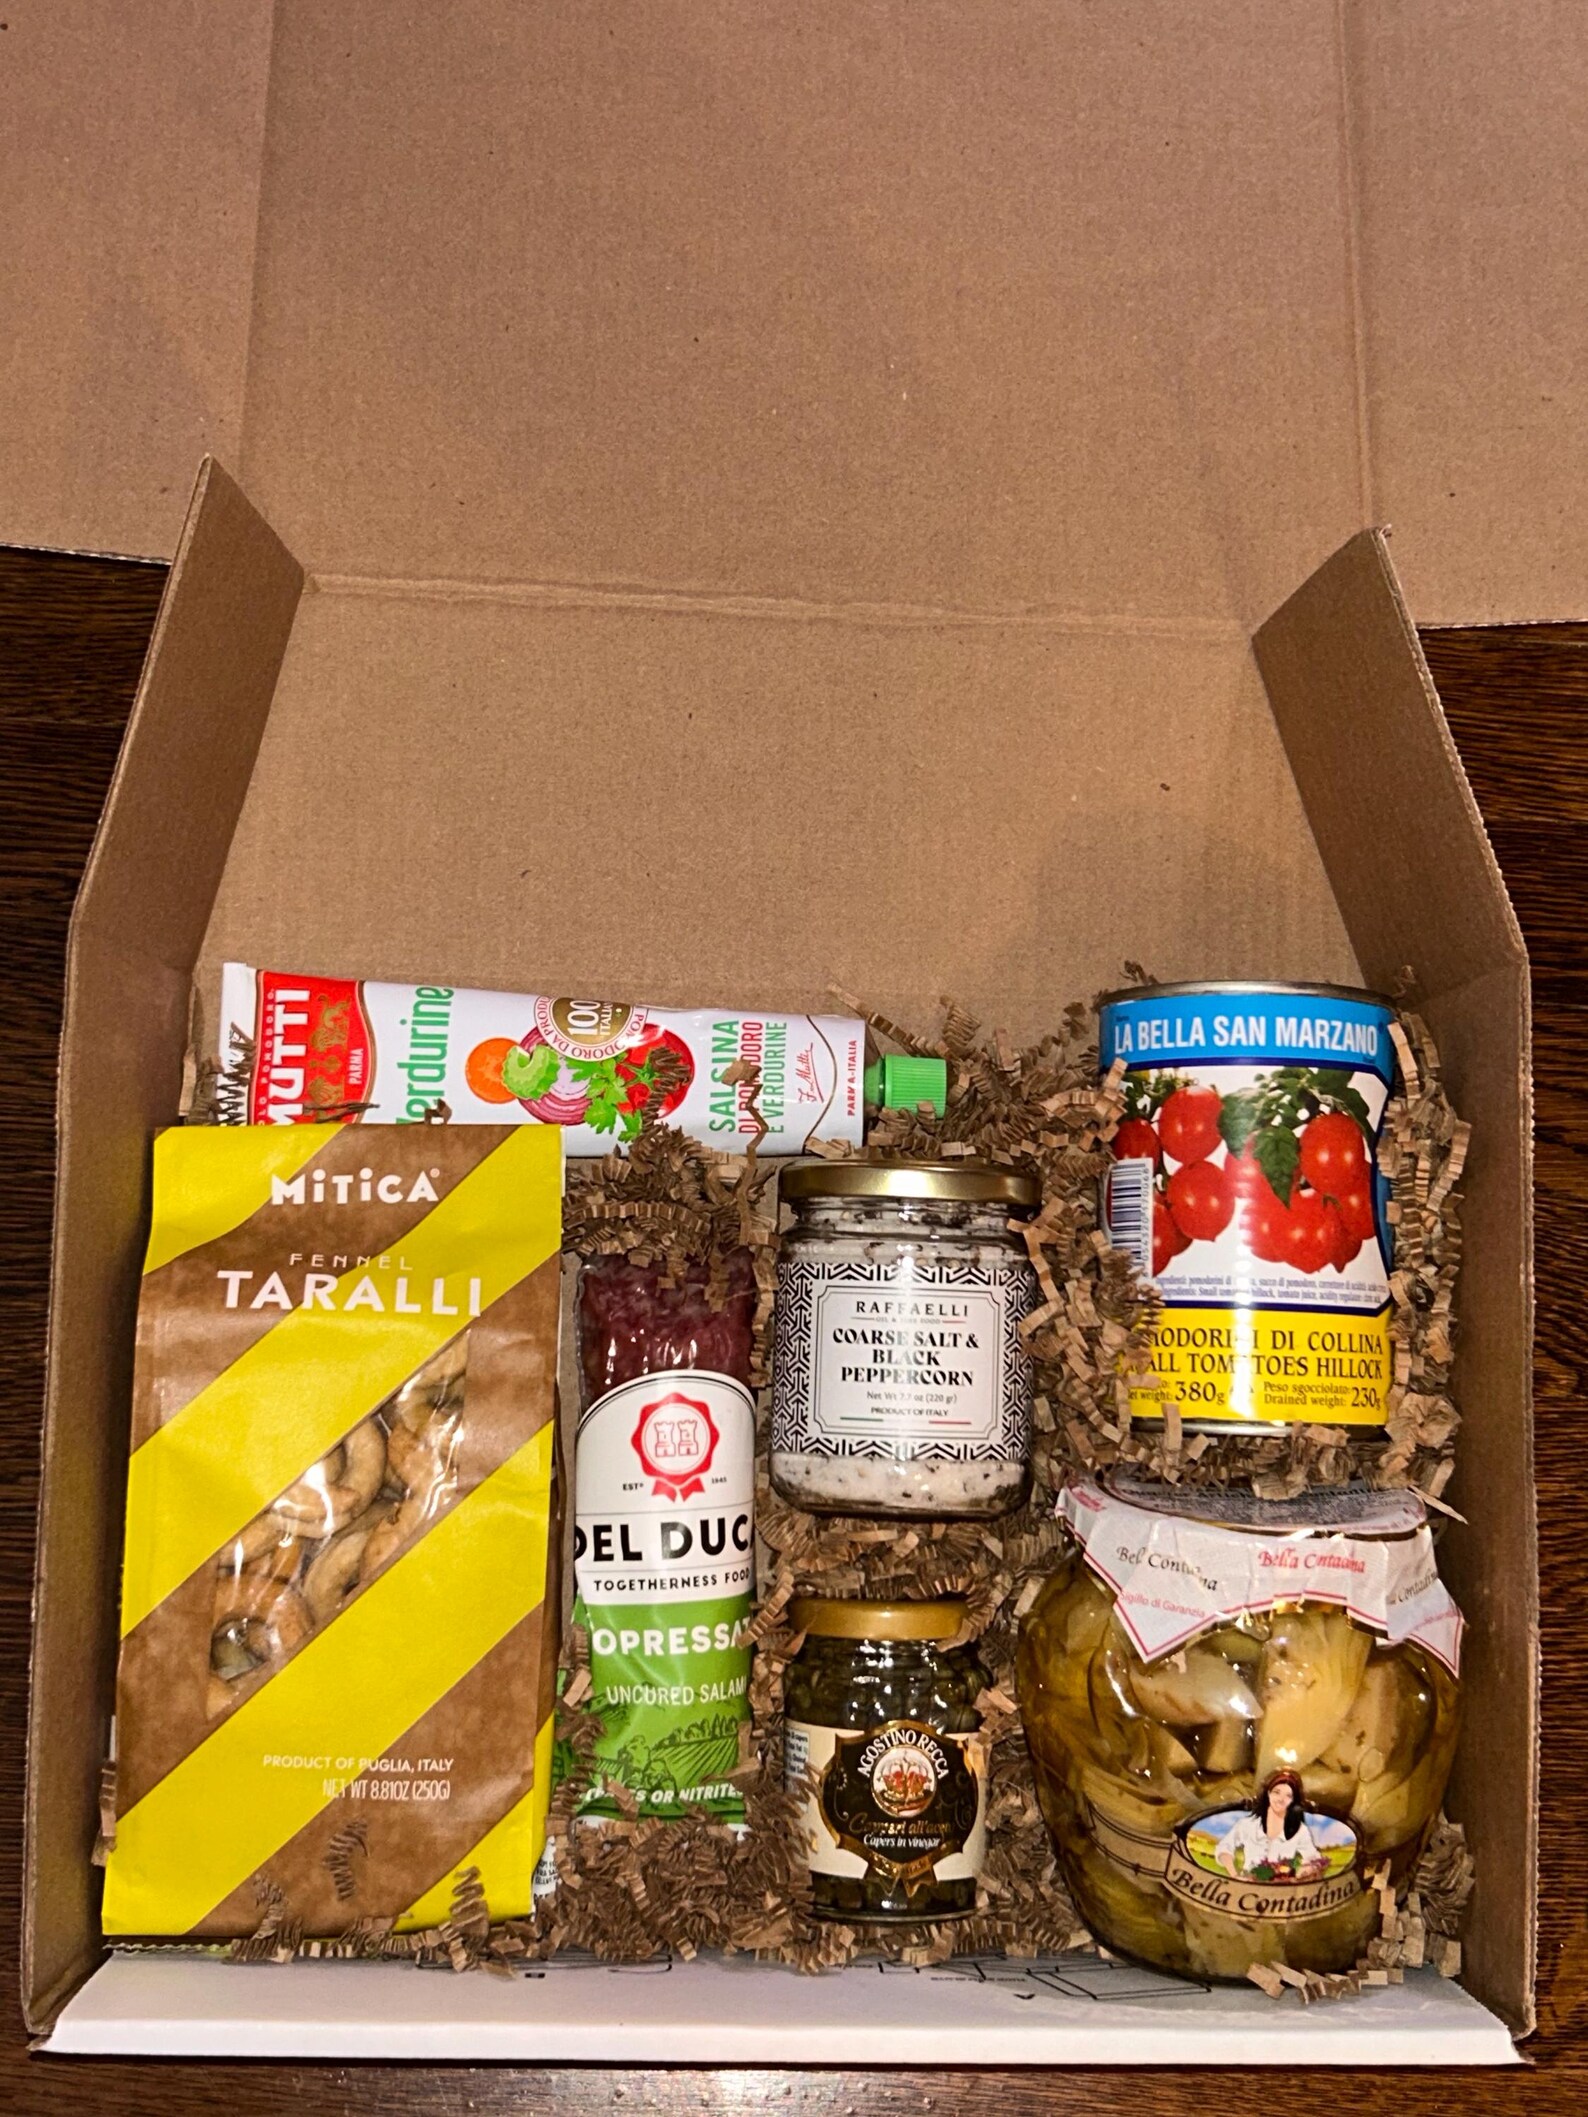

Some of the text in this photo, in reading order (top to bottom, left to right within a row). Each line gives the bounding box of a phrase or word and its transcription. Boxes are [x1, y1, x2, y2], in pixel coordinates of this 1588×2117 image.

[567, 999, 602, 1036] 100
[1114, 1016, 1378, 1057] LA BELLA SAN MARZANO
[268, 989, 311, 1126] MUTTI
[348, 1048, 364, 1085] PARMA
[708, 1020, 739, 1133] SALSINA
[762, 1021, 788, 1119] VERDURINE
[289, 1252, 413, 1271] FENNEL
[216, 1270, 482, 1318] TARALLI
[855, 1300, 969, 1317] RAFFAELLI
[832, 1328, 980, 1349] COARSE SALT &
[1152, 1327, 1383, 1355] ODORII DI COLLINA
[872, 1350, 941, 1366] BLACK
[1186, 1352, 1309, 1377] TOMTOES
[1316, 1357, 1383, 1380] HILLOCK
[841, 1367, 974, 1386] PEPPERCORN
[1263, 1381, 1289, 1393] Peso
[866, 1391, 882, 1400] Net
[884, 1392, 899, 1401] Wt
[1264, 1393, 1307, 1406] Drained
[871, 1406, 949, 1417] PRODUCT OF ITALY
[574, 1513, 753, 1563] DEL DUC
[1115, 1546, 1146, 1565] Bel
[593, 1574, 718, 1592] TOGETHERNESS
[1151, 1599, 1161, 1609] di
[591, 1616, 751, 1657] OPRESSA
[605, 1685, 695, 1706] UNCURED
[262, 1754, 455, 1774] PRODUCT OF PUGLIA, ITALY
[857, 1728, 918, 1778] AGOSTINO
[916, 1733, 950, 1780] RECCA
[323, 1778, 347, 1799] NET
[351, 1780, 369, 1799] WT
[412, 1779, 450, 1801] (250G)
[650, 1788, 674, 1804] OR
[679, 1782, 744, 1802] NITRITE
[863, 1832, 942, 1850] Capers in vinegar
[1171, 1867, 1355, 1914] Bella Contadina
